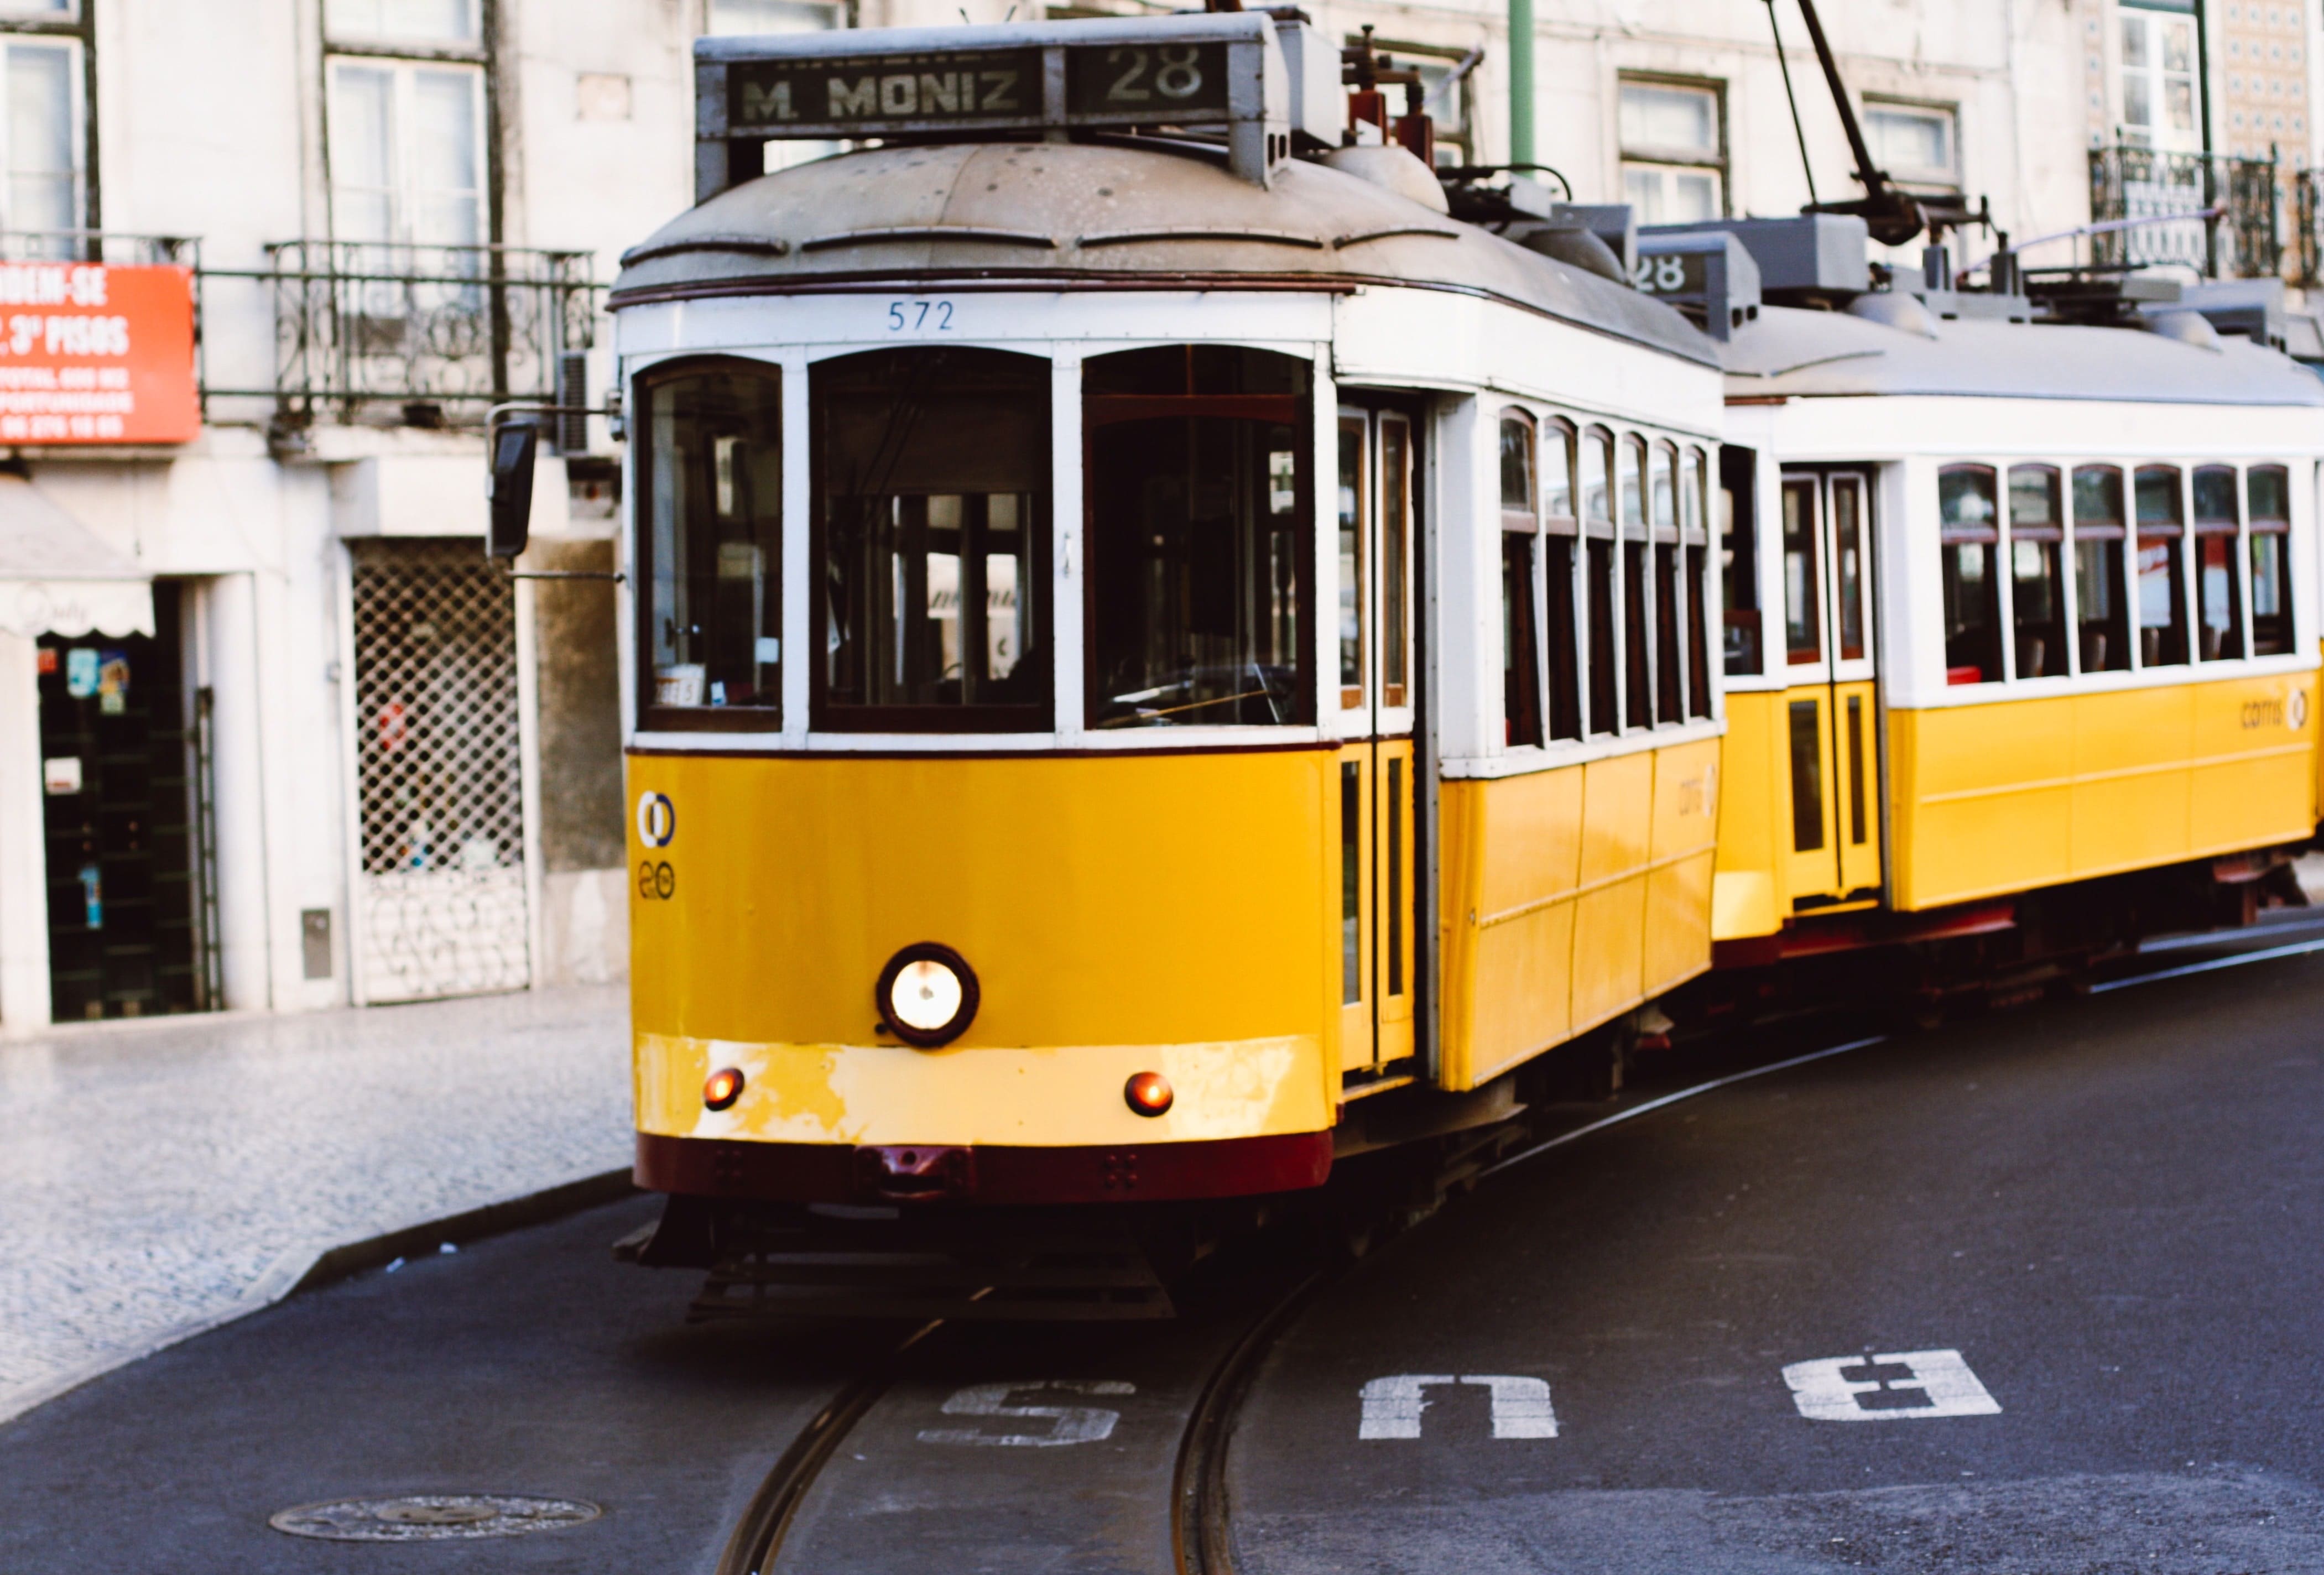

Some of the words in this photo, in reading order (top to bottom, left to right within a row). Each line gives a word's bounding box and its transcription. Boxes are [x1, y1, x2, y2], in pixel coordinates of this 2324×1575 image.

[1107, 46, 1202, 100] 28
[744, 81, 799, 120] M.
[828, 72, 1018, 118] MONIZ
[1635, 255, 1685, 291] 28
[45, 315, 129, 356] PISOS
[889, 300, 953, 330] 572
